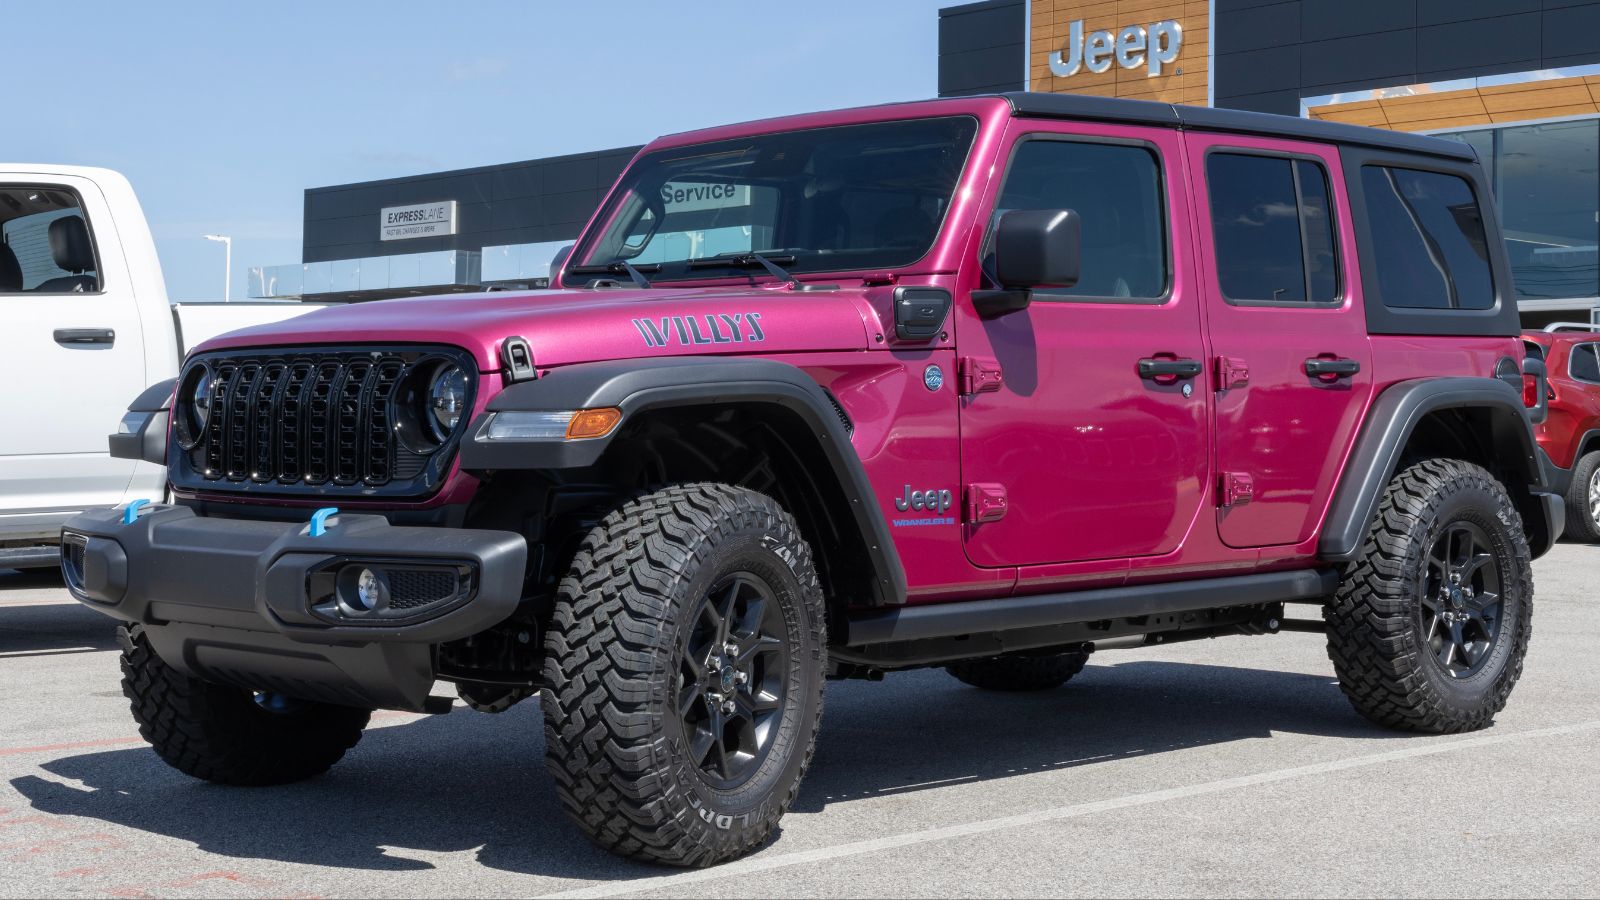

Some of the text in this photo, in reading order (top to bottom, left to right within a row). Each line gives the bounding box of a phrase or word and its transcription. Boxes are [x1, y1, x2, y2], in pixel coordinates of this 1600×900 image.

[1049, 19, 1183, 77] Jeep
[661, 183, 735, 204] Service
[632, 312, 765, 347] WILLYS
[896, 484, 952, 515] Jeep
[892, 517, 945, 527] WRANGLER
